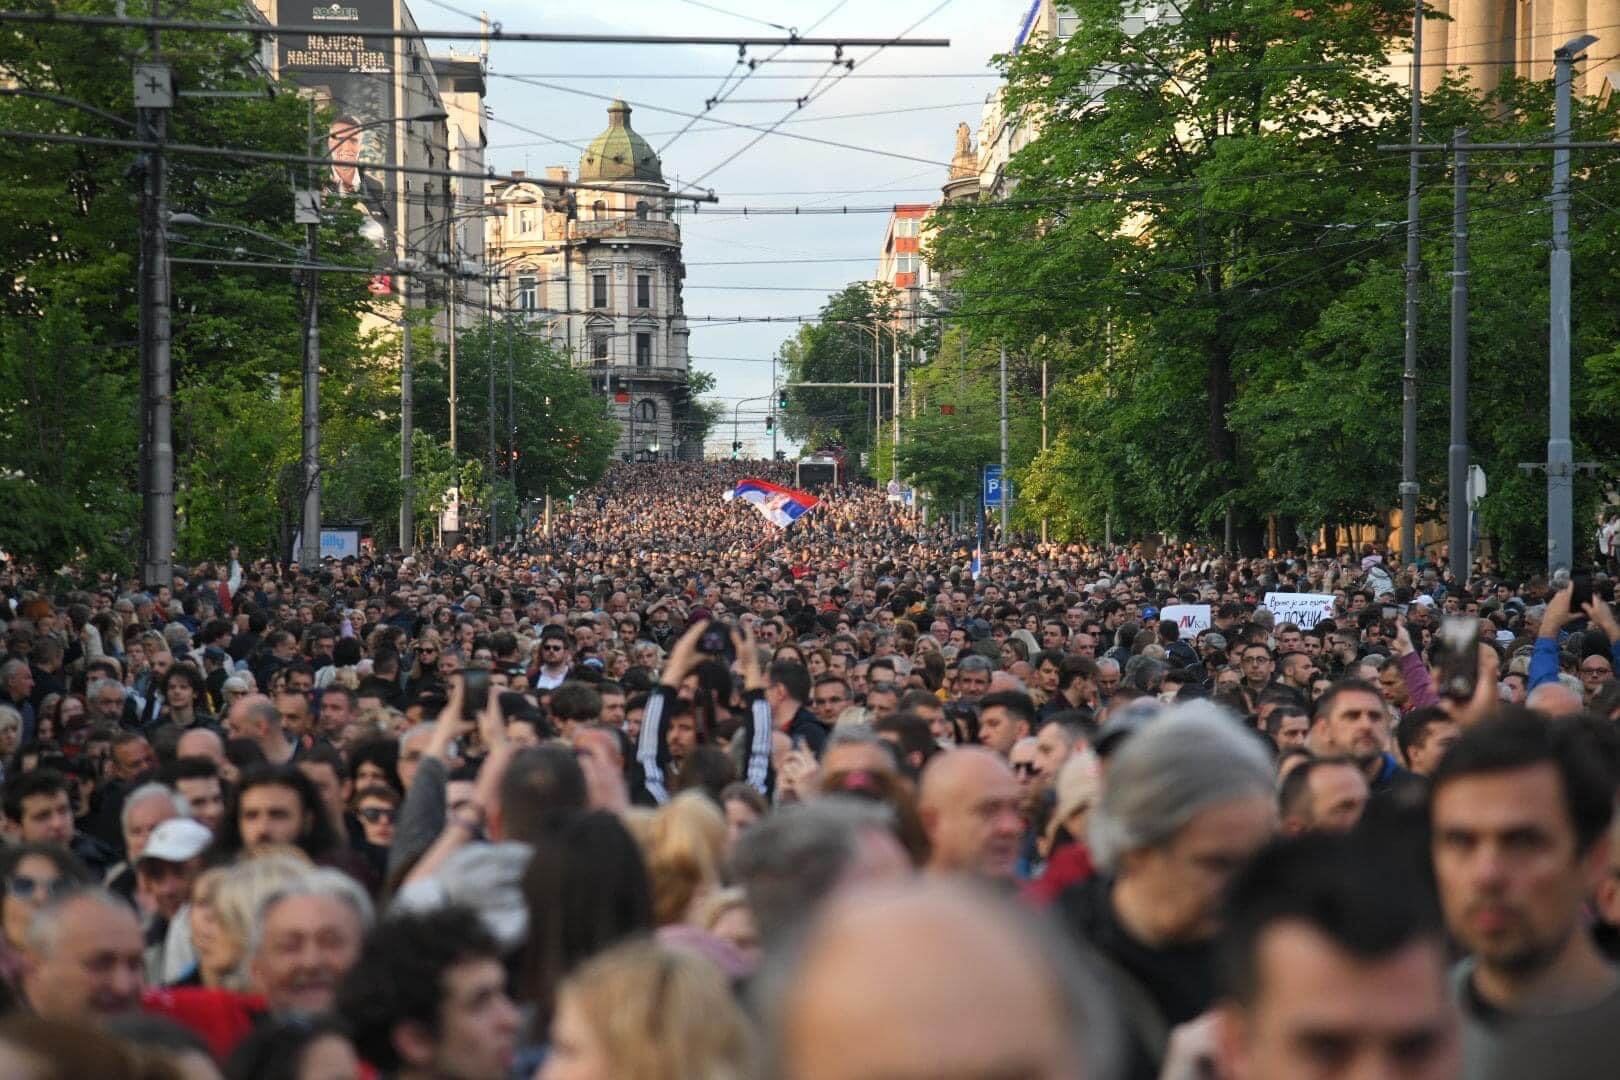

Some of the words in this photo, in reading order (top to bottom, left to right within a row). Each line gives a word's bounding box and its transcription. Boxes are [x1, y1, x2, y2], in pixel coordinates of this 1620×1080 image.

[287, 50, 353, 66] NAGRADNA
[356, 51, 385, 66] IGRA
[988, 479, 999, 494] P
